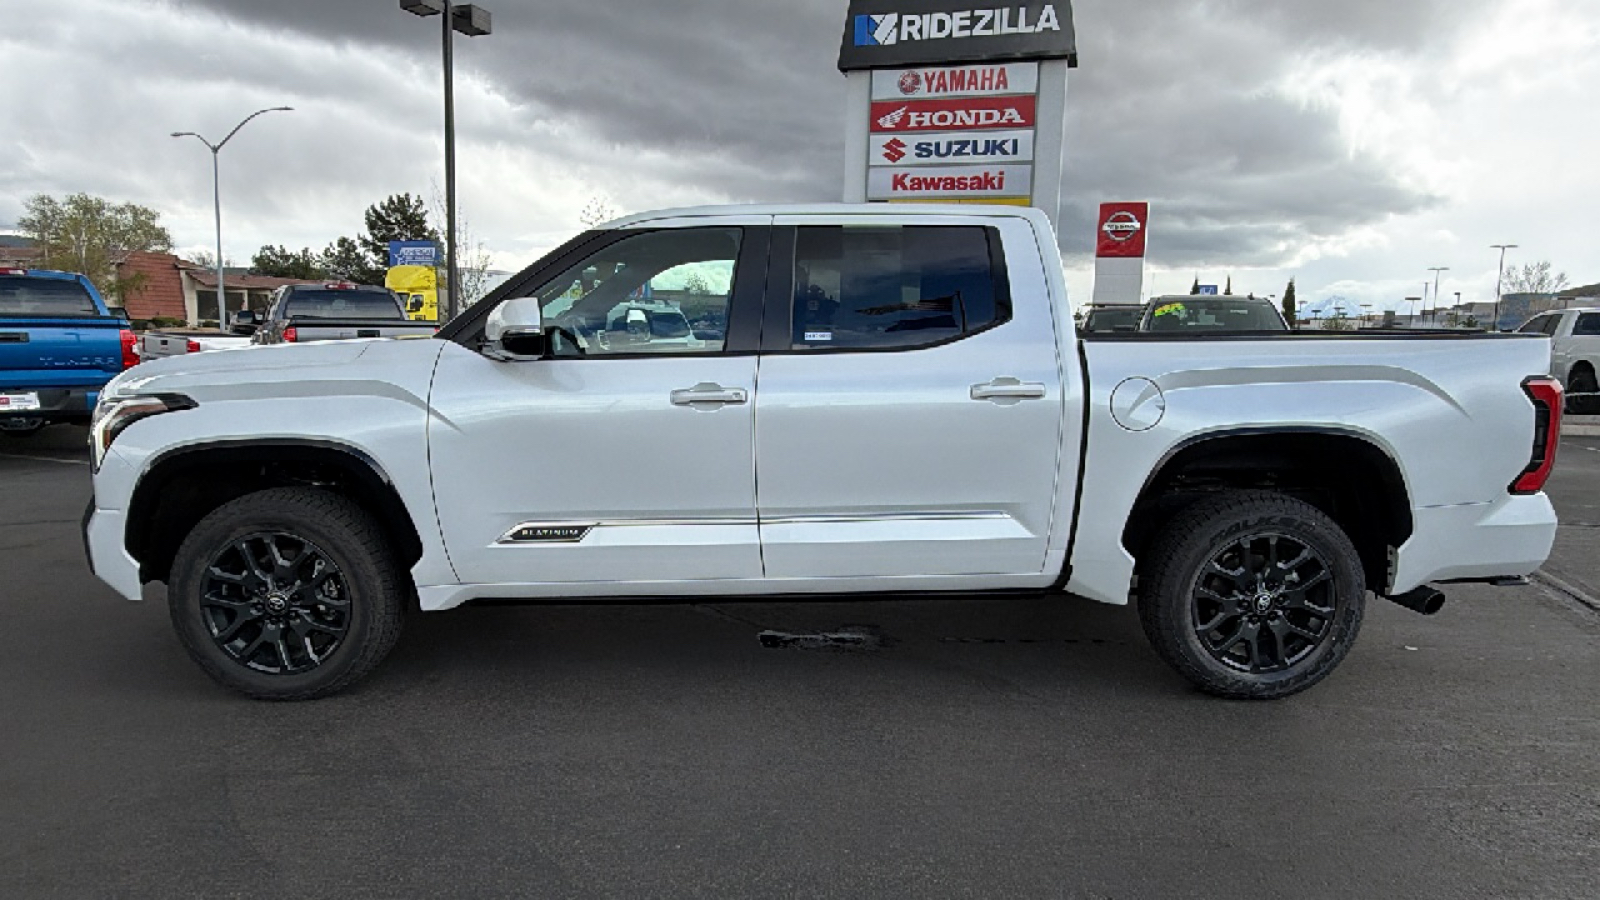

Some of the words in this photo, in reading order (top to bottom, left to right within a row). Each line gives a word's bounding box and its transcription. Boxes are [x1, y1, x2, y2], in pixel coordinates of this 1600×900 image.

[900, 5, 1060, 41] RIDEZILLA
[924, 67, 1009, 94] YAMAHA
[907, 108, 1025, 128] HONDA
[914, 138, 1018, 159] SUZUKI
[892, 171, 1005, 191] Kawasaki
